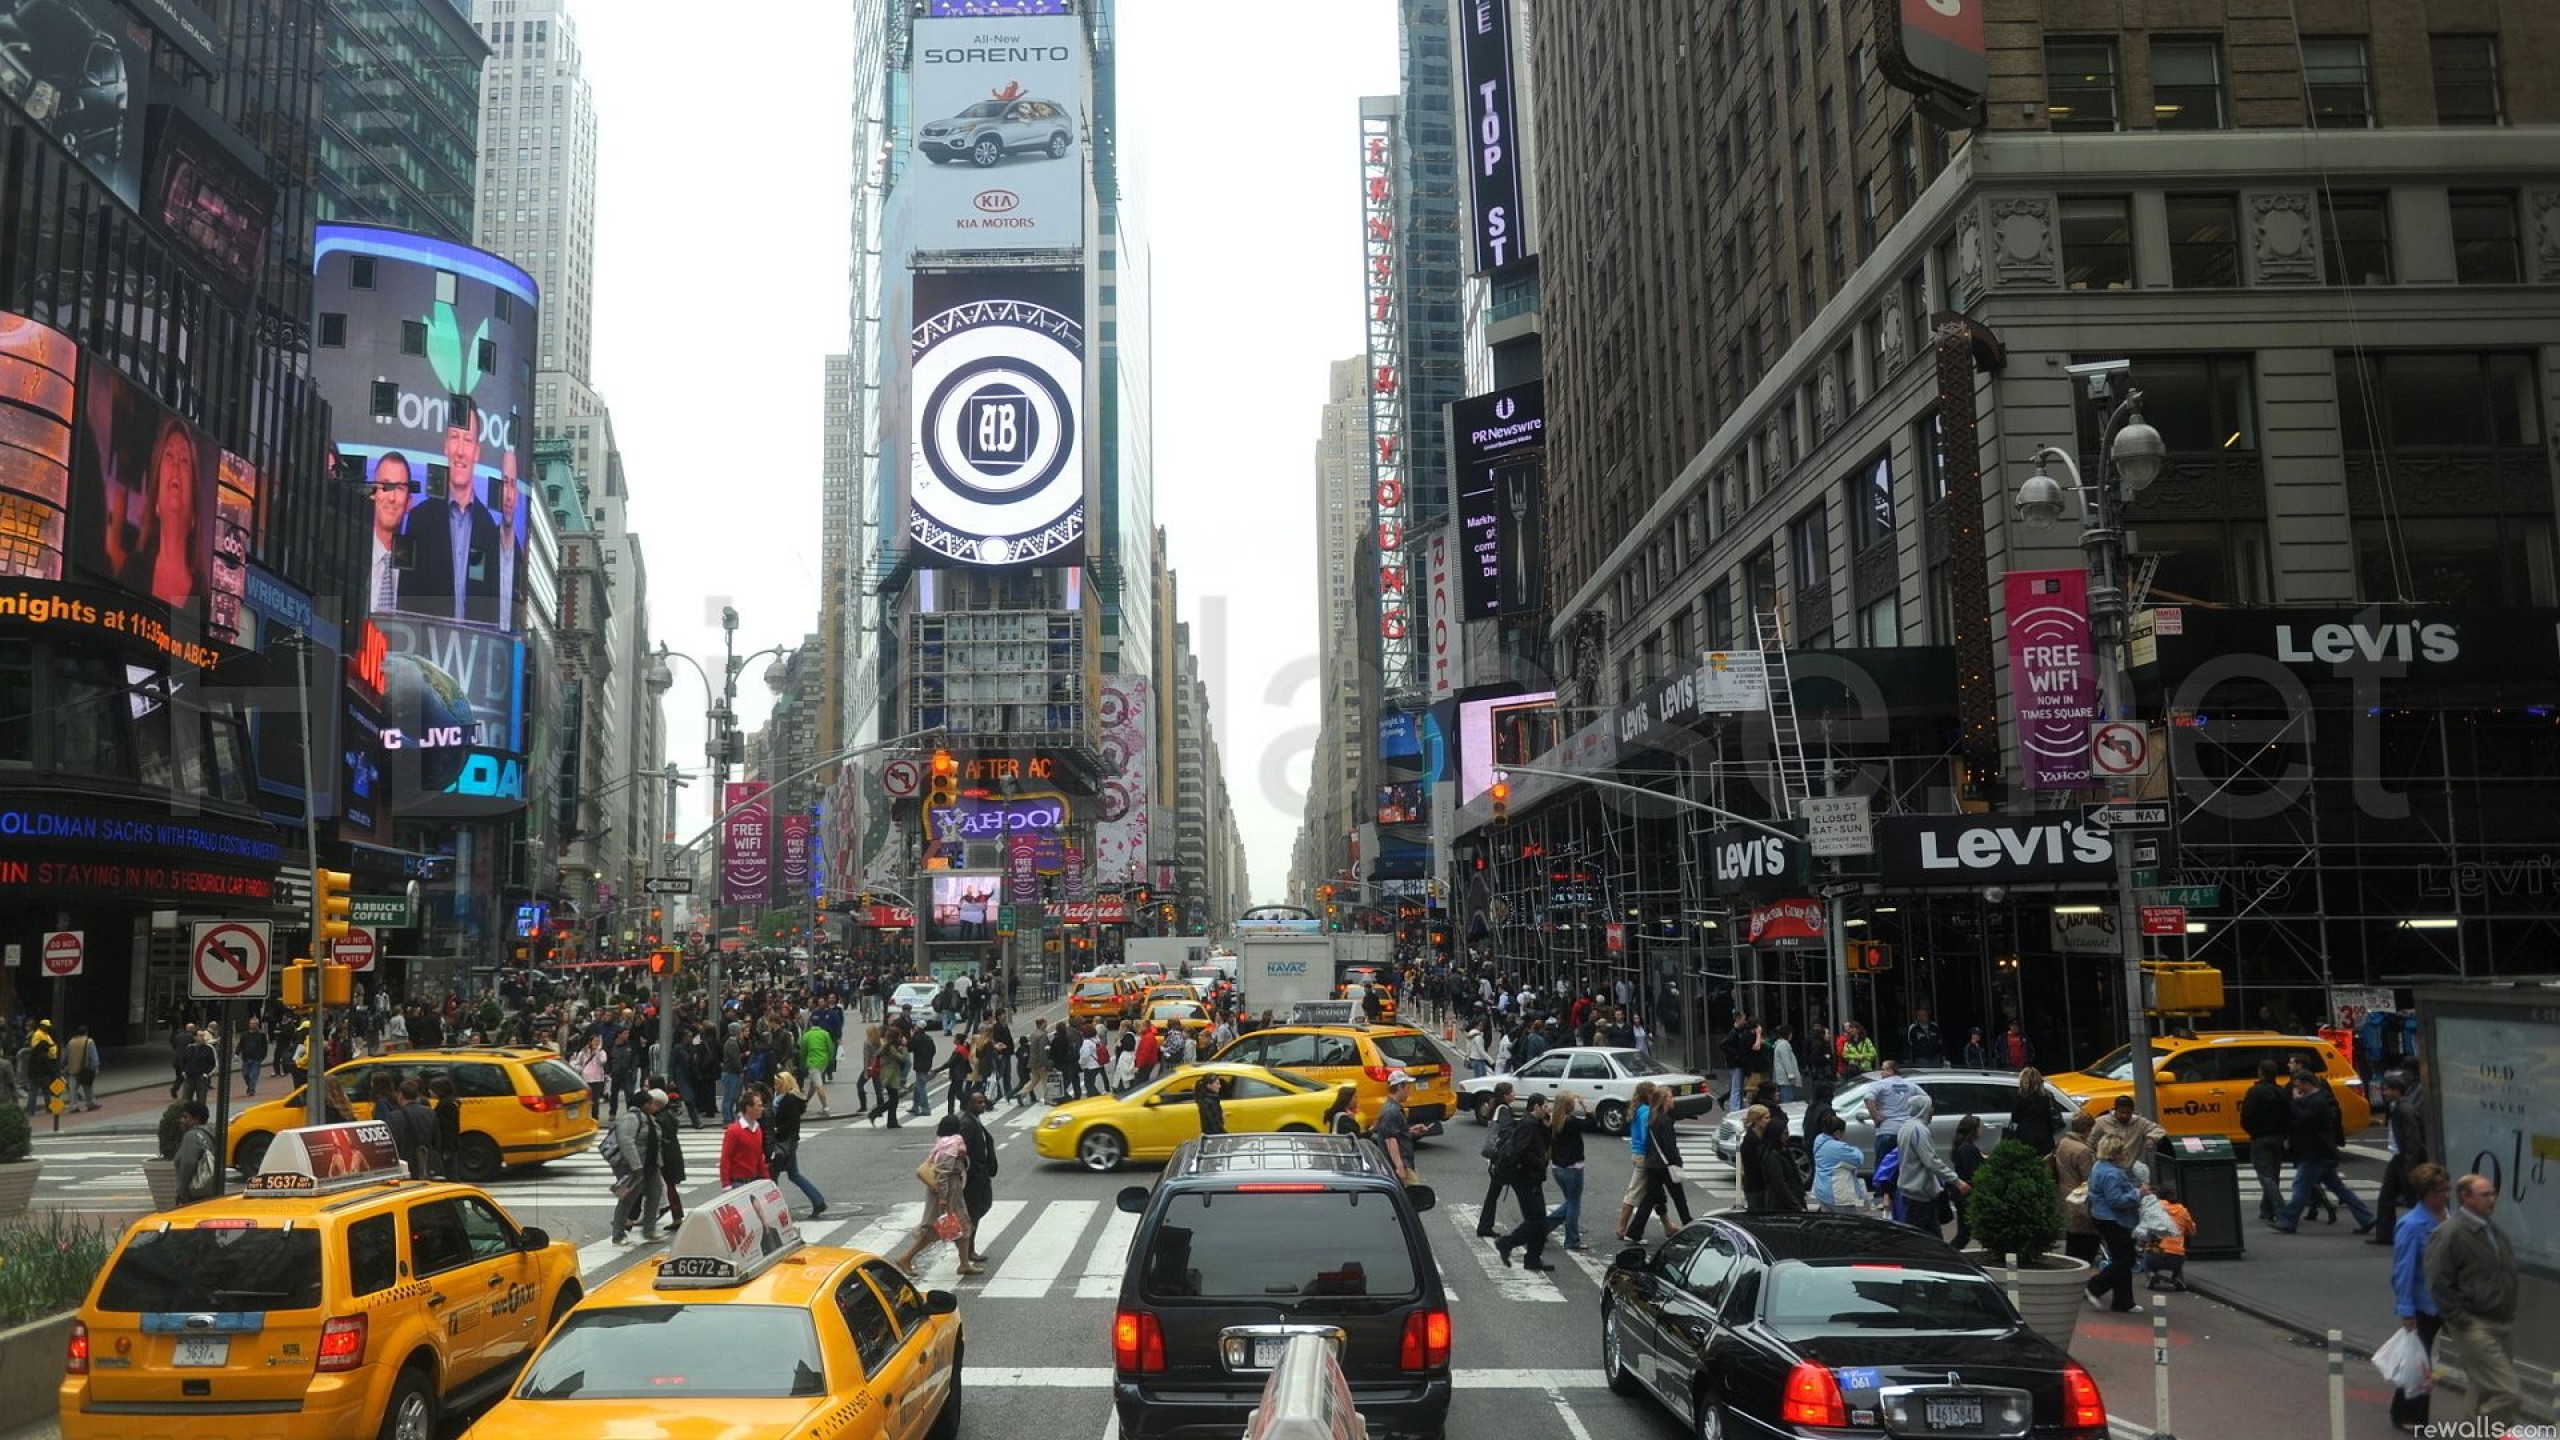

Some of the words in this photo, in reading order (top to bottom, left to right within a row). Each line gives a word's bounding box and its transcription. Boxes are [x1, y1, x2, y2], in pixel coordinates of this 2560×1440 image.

[925, 46, 1069, 64] SORENTO
[982, 195, 1011, 208] KIA
[957, 219, 977, 228] KIA
[982, 218, 1034, 228] MOTORS
[0, 592, 96, 622] nights
[104, 609, 125, 630] at
[1433, 536, 1448, 691] RICOH
[2023, 644, 2081, 669] FREE
[2029, 669, 2079, 692] WIFI
[2037, 695, 2060, 706] NOW
[2063, 694, 2074, 705] IN
[2021, 709, 2051, 720] TIMES
[2054, 707, 2093, 719] SQUARE
[420, 727, 461, 749] JVC
[965, 758, 1019, 780] AFTER
[1815, 814, 1857, 824] CLOSED
[2100, 812, 2123, 822] ONE
[2136, 810, 2160, 821] WAY
[102, 819, 153, 843] SACHS
[157, 824, 184, 847] WITH
[732, 824, 763, 836] FREE
[734, 837, 761, 849] WIFI
[38, 862, 119, 886] STAYING
[126, 867, 142, 888] IN
[2178, 888, 2200, 905] 44
[2204, 889, 2214, 897] ST
[352, 912, 393, 921] COFFEE
[50, 941, 60, 949] DO
[62, 940, 76, 948] NOT
[352, 936, 367, 944] NOT
[51, 959, 73, 968] ENTER
[341, 953, 365, 962] ENTER
[356, 1126, 390, 1143] BODIES
[267, 1175, 297, 1189] 5G37
[678, 1260, 714, 1275] 6G72
